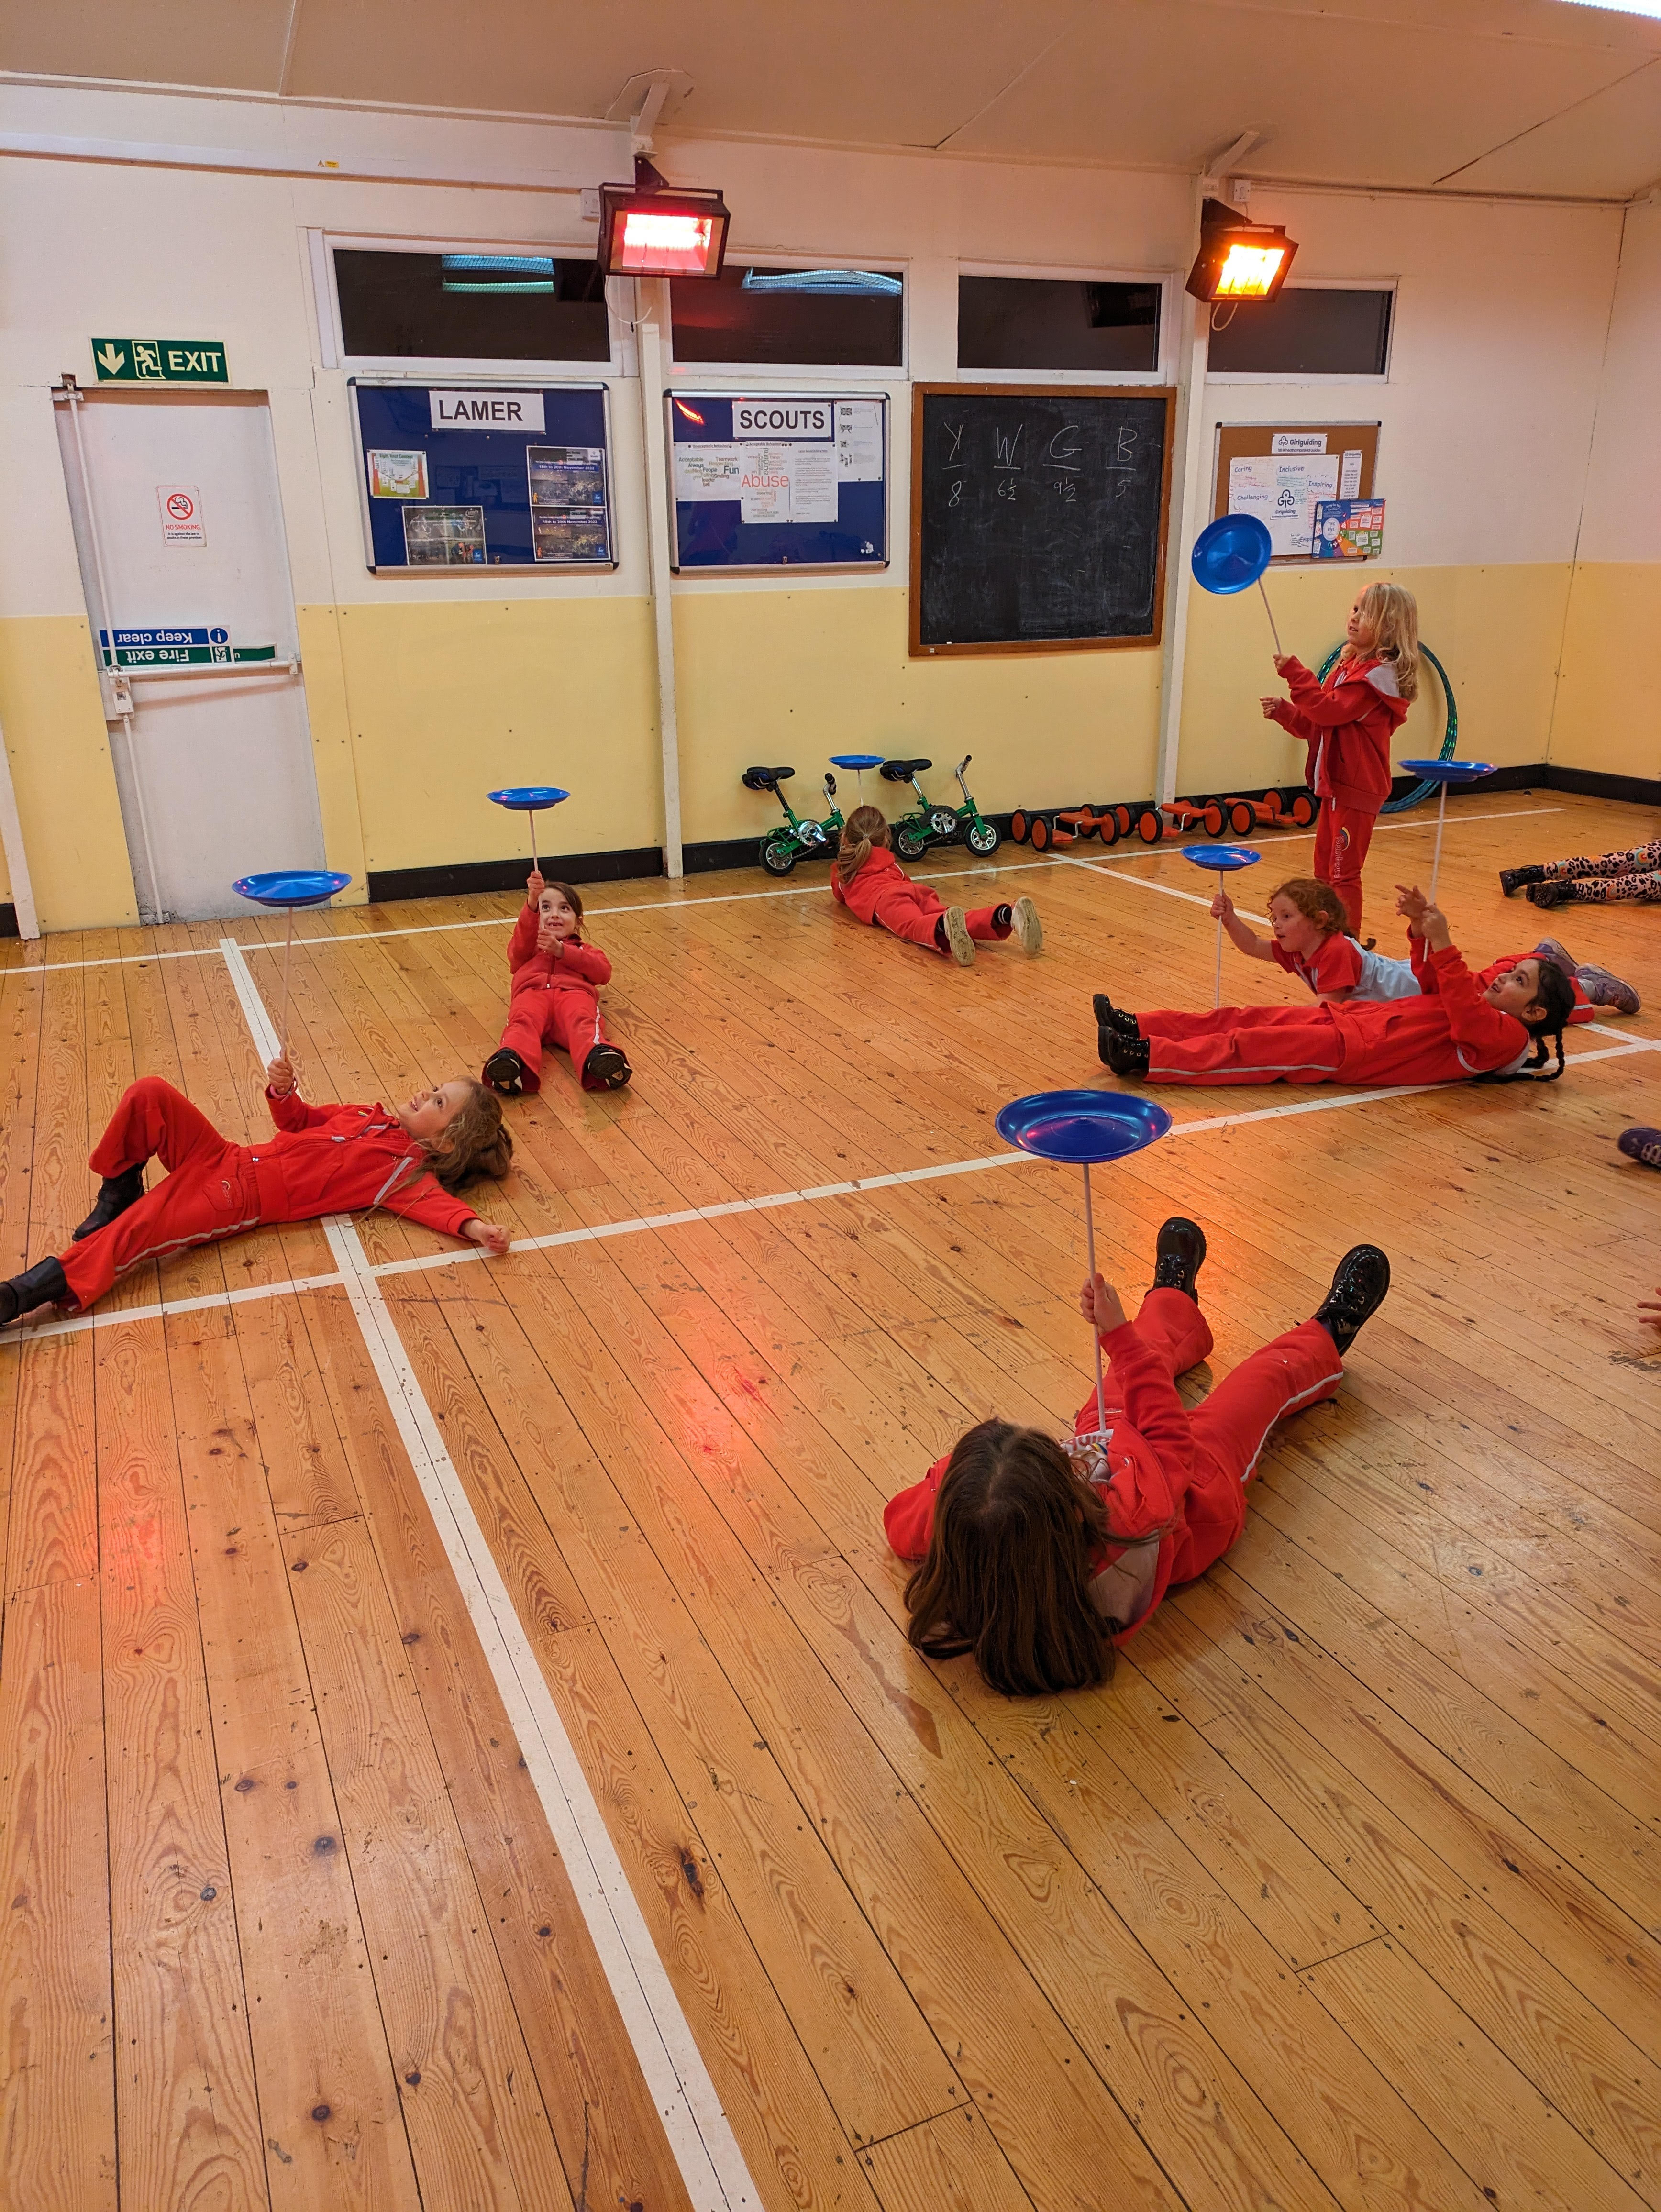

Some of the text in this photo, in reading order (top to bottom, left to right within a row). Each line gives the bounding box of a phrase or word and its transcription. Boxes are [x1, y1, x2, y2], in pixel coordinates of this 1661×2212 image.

[168, 351, 221, 372] EXIT
[439, 400, 523, 421] LAMER
[740, 410, 824, 429] SCOUTS
[997, 424, 1023, 466] W
[1050, 425, 1082, 458] G
[1117, 426, 1137, 461] B
[1290, 439, 1322, 447] Girlguiding
[723, 465, 740, 474] Fun
[742, 474, 789, 487] Abuse
[949, 481, 962, 507] 8
[1116, 480, 1131, 497] 5
[117, 630, 193, 643] Keep clear
[126, 649, 189, 663] Fire exit
